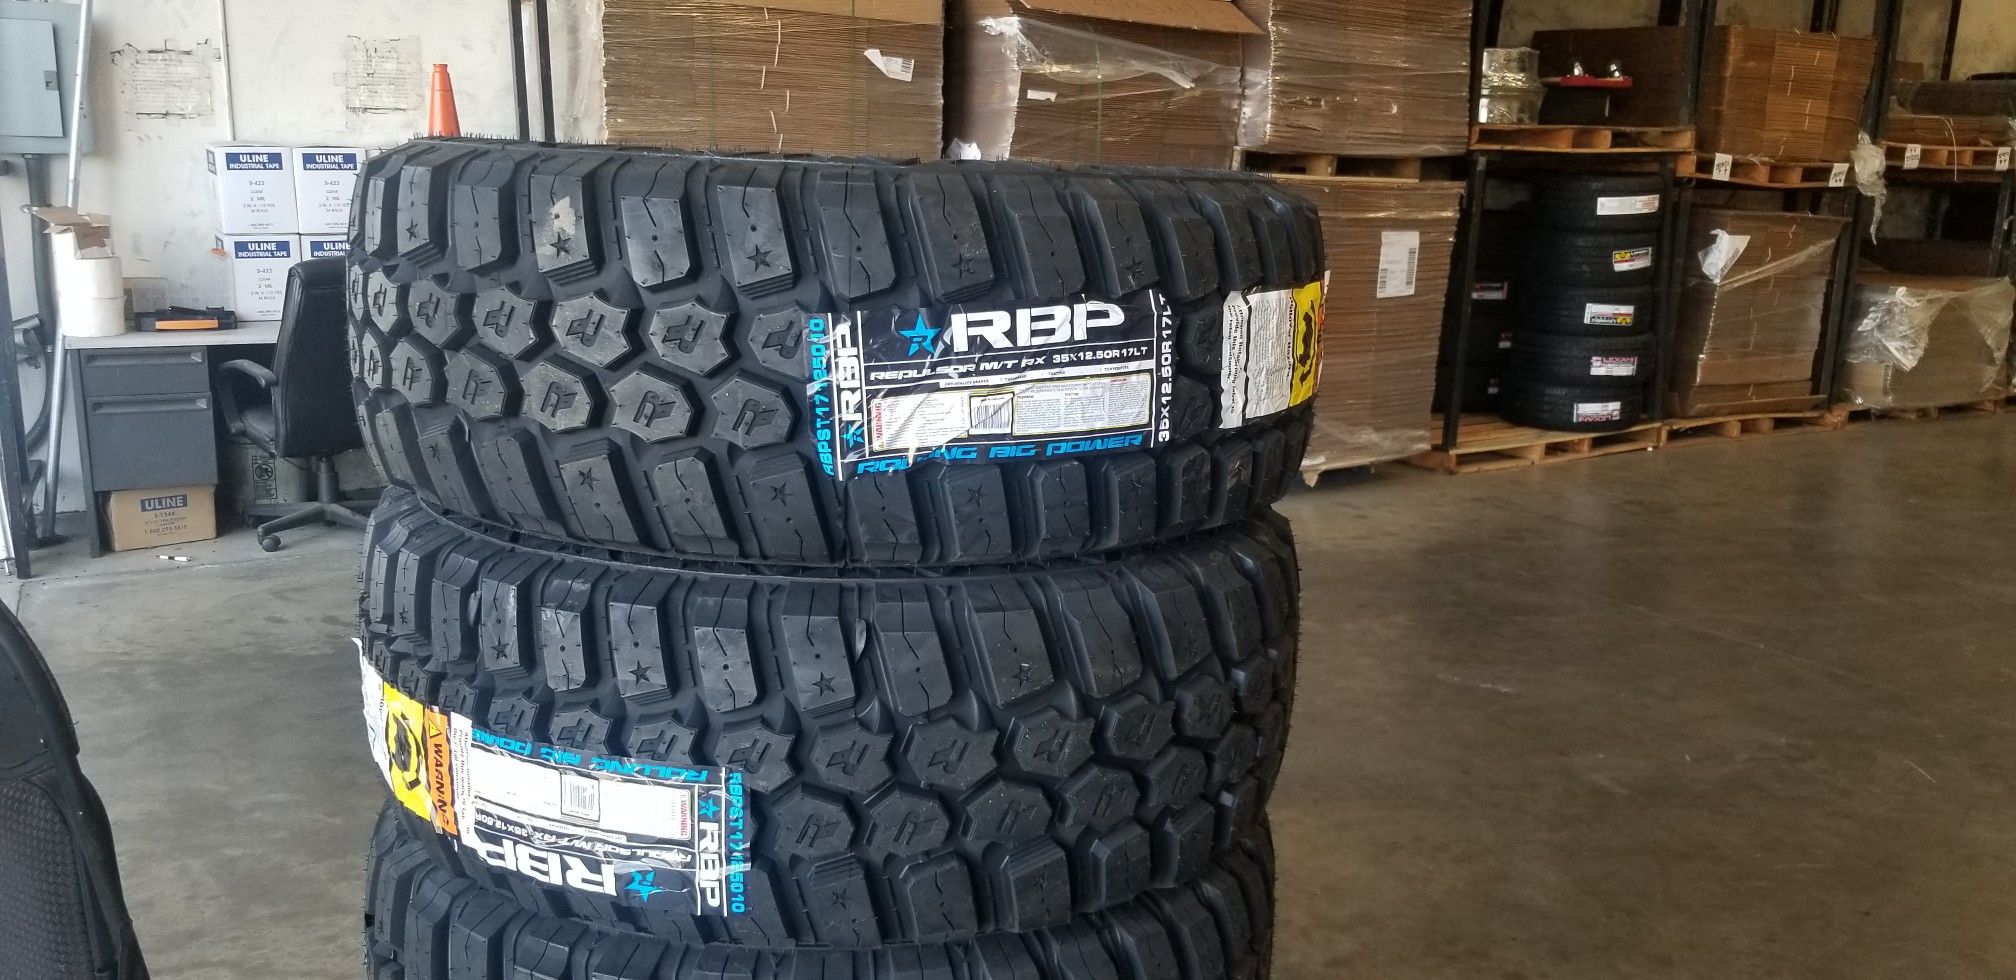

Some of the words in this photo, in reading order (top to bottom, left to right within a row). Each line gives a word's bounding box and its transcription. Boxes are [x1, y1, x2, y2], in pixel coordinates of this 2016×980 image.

[239, 154, 269, 163] ULINE
[315, 154, 344, 163] ULINE
[247, 242, 277, 251] ULINE
[323, 242, 351, 250] ULINE
[951, 302, 1125, 352] RBP
[836, 323, 863, 421] RBP
[869, 364, 976, 381] REPULSOR
[979, 359, 1019, 371] M/T
[1021, 355, 1047, 368] RX
[1052, 346, 1148, 363] 35X12.50R17LT
[989, 443, 1042, 459] BIG
[1046, 434, 1143, 457] POWER
[145, 496, 184, 510] ULINE
[472, 727, 531, 756] POWE
[540, 746, 582, 766] BIG
[590, 755, 708, 782] ROLLING
[475, 809, 528, 837] 35X12.50R
[680, 799, 688, 837] WARNING
[475, 838, 617, 897] RBP
[700, 821, 720, 908] RBP
